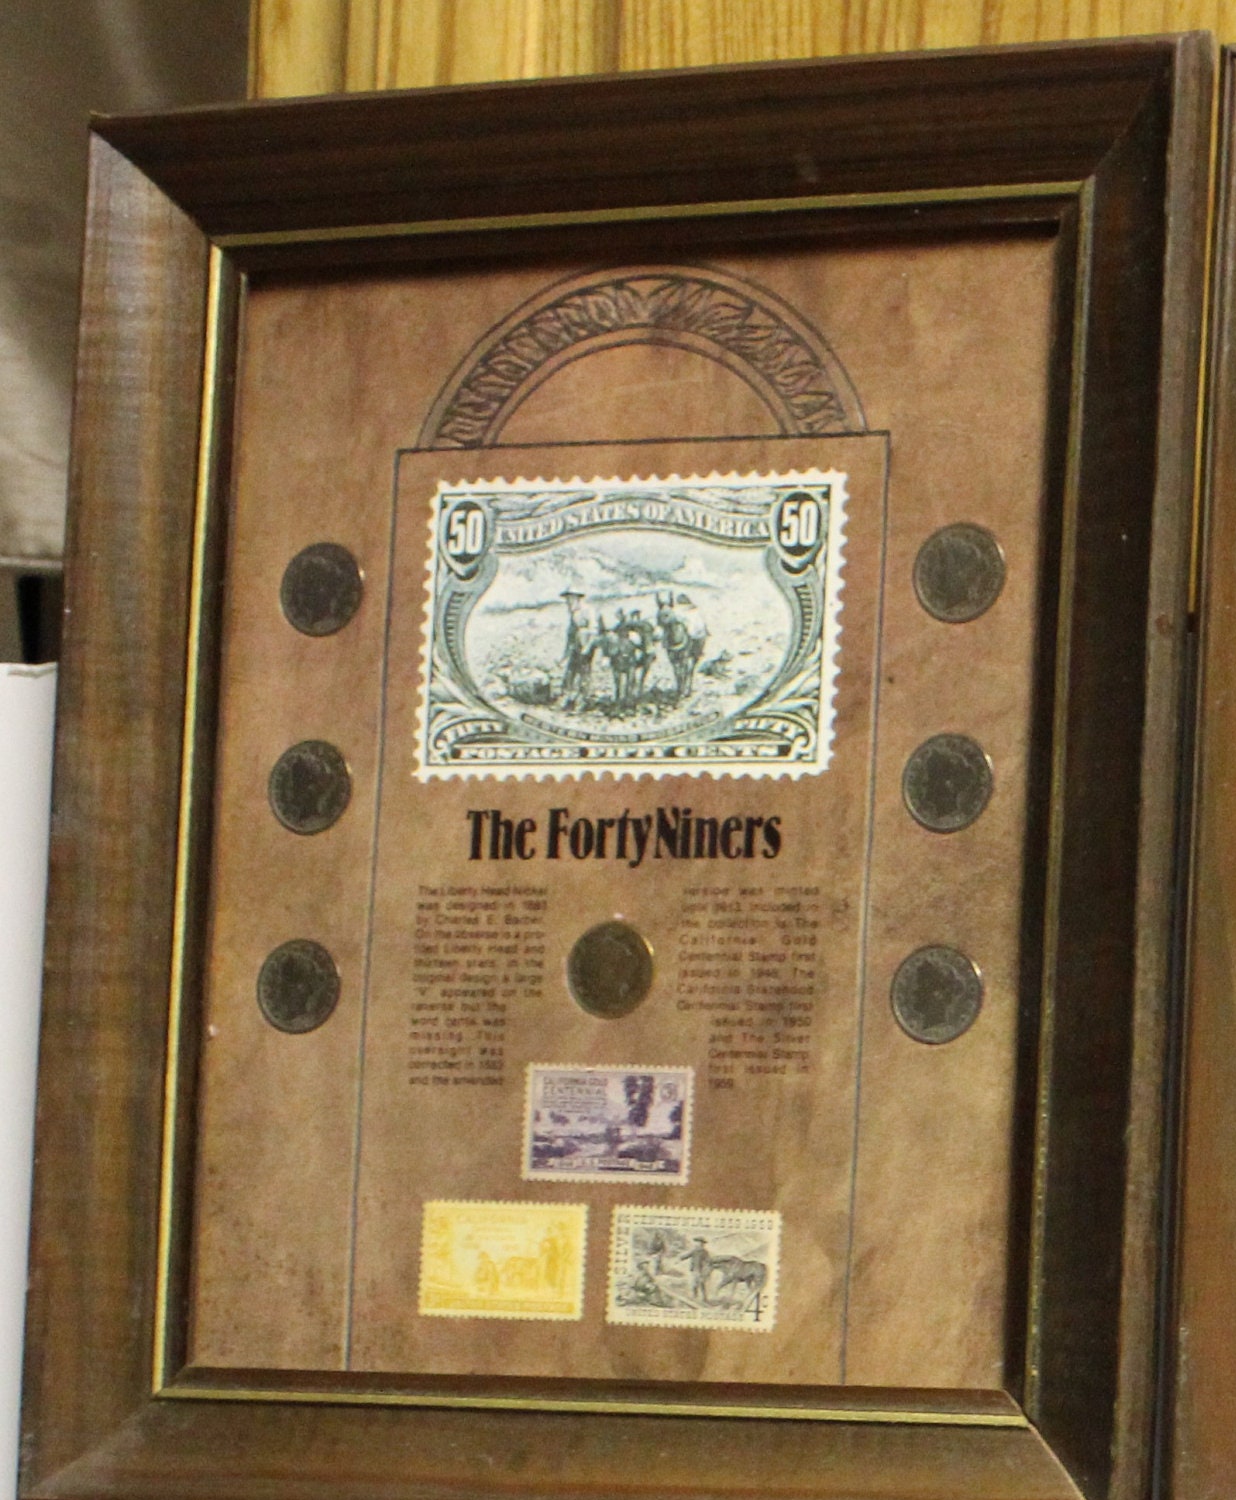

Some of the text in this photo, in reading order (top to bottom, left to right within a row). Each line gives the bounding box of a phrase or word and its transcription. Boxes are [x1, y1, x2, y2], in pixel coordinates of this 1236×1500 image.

[448, 510, 484, 554] 50
[496, 502, 770, 543] UNITED STATES OF AMERICA
[780, 503, 816, 547] 50
[445, 721, 508, 743] FIFTY
[735, 719, 805, 739] FIFTY
[461, 746, 779, 759] POSTAGE FIFTY CENTS
[467, 809, 537, 860] The
[615, 1214, 631, 1275] SILVER
